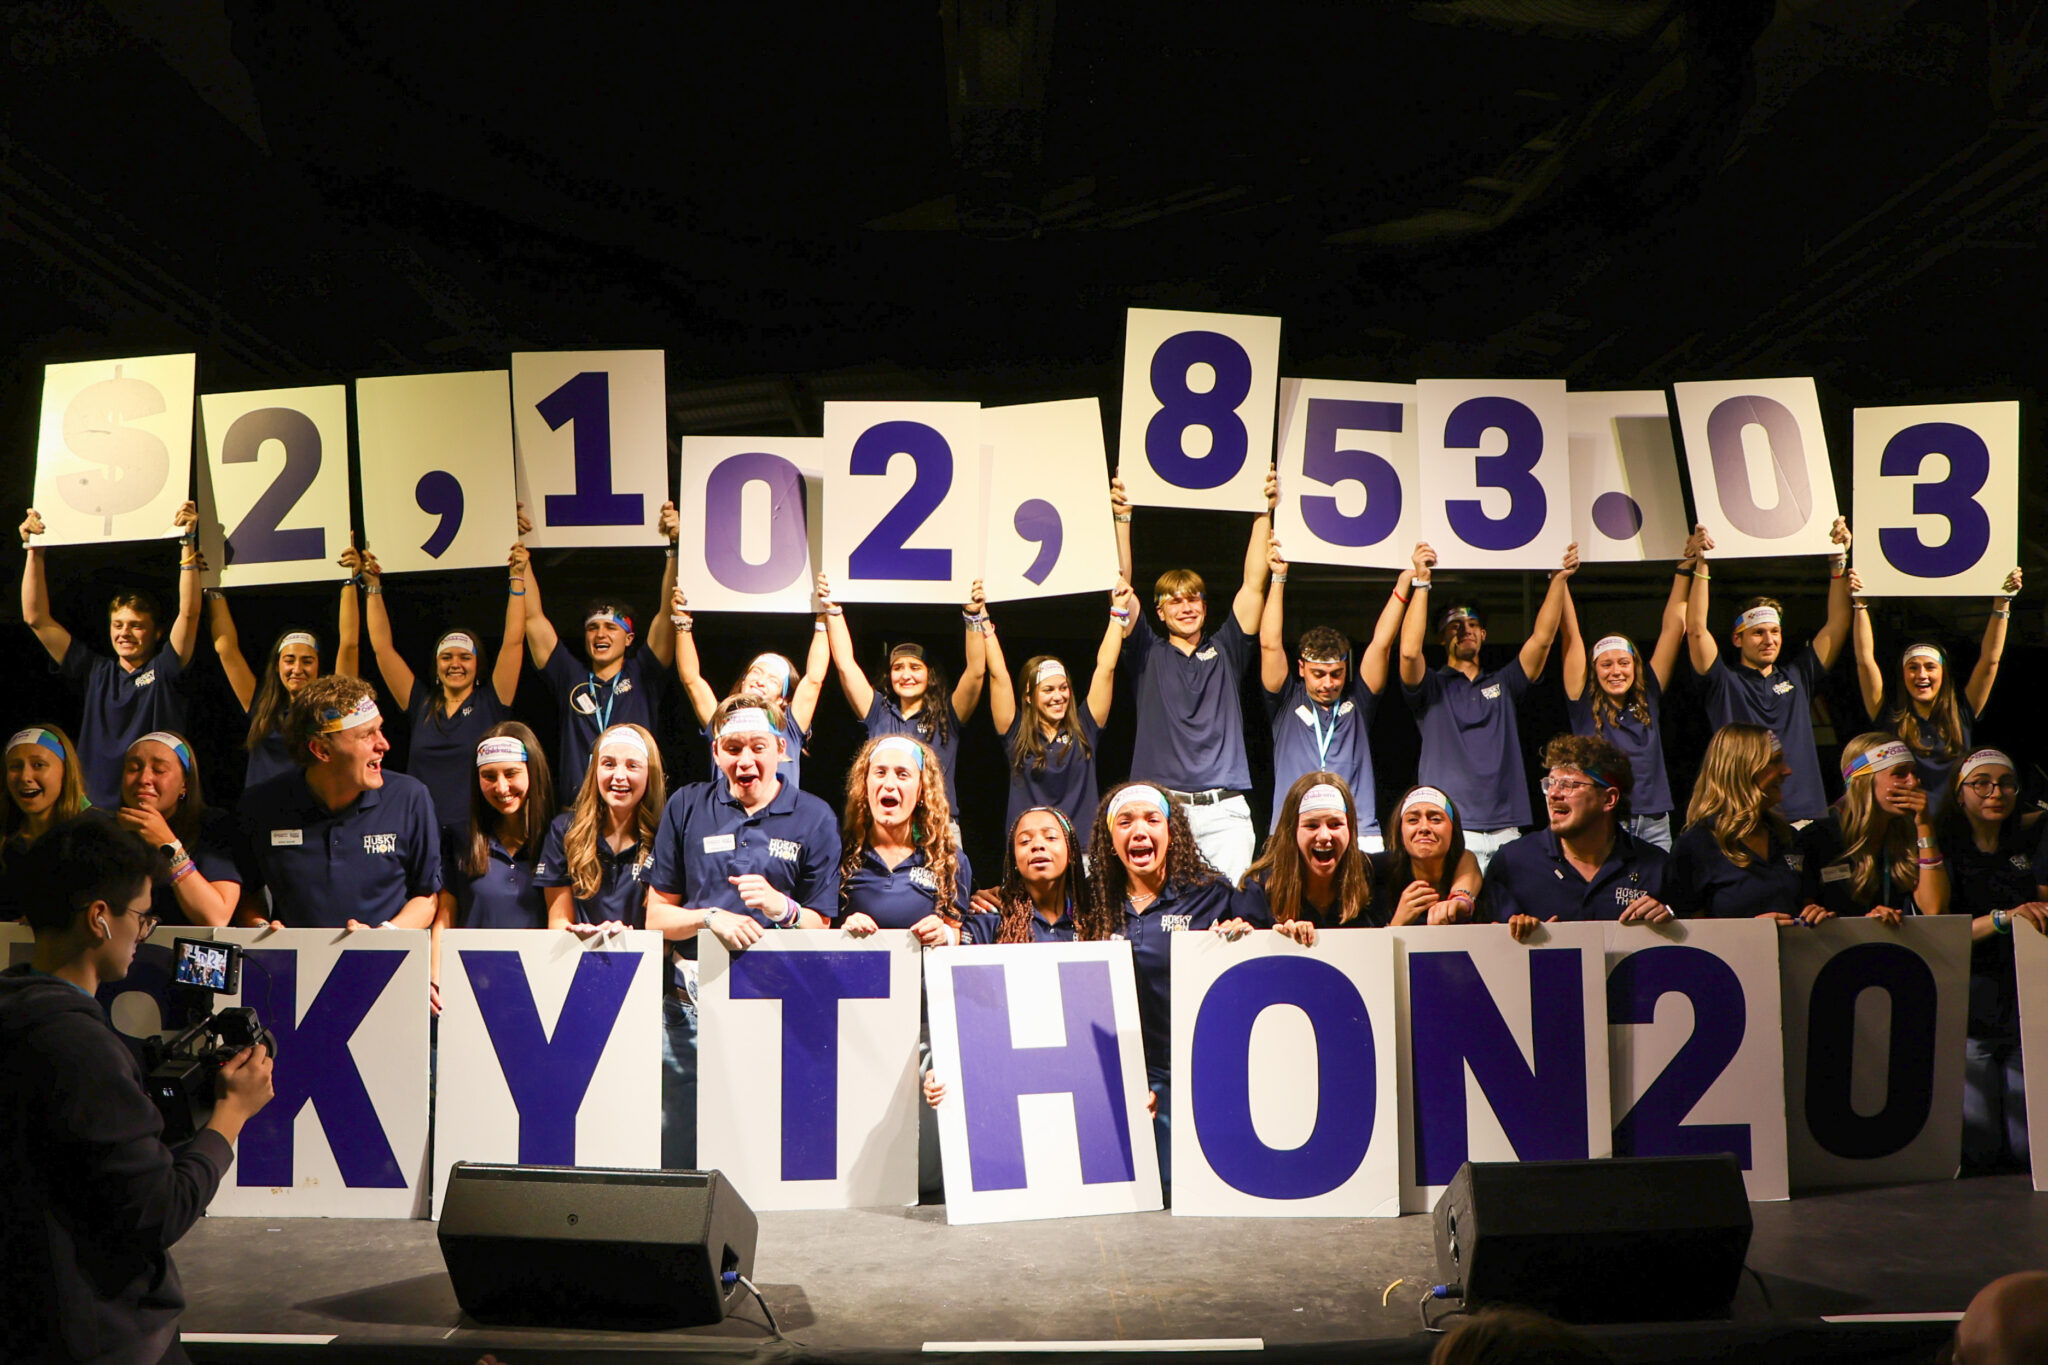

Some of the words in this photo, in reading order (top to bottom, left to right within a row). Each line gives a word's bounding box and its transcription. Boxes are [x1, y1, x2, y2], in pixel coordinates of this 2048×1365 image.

[363, 834, 397, 847] HUSKY
[768, 838, 802, 854] HUSKY
[1160, 914, 1193, 927] HUSKY
